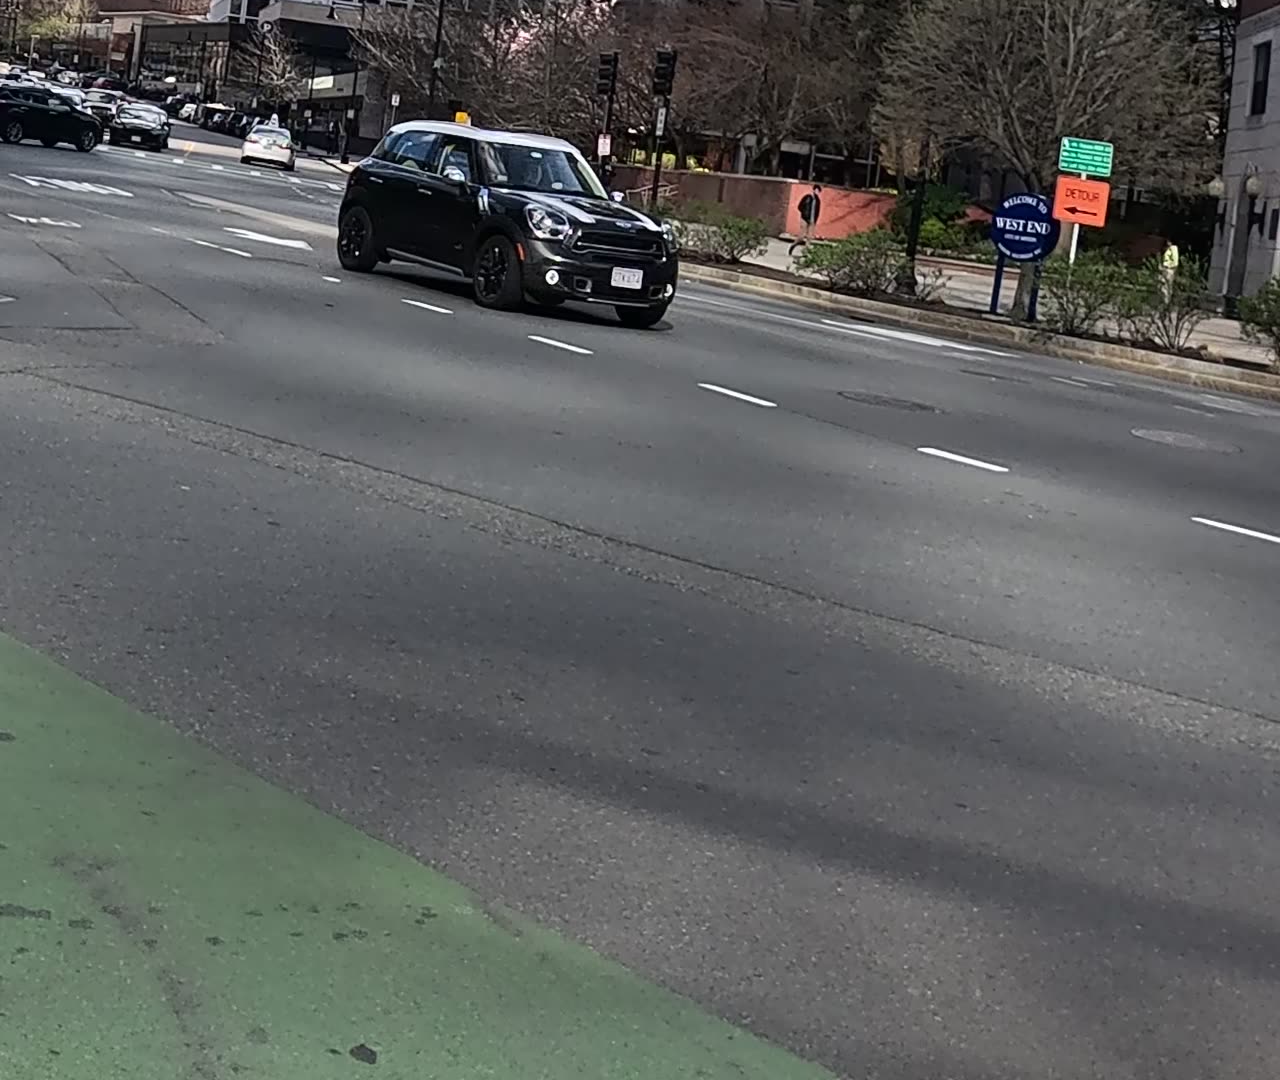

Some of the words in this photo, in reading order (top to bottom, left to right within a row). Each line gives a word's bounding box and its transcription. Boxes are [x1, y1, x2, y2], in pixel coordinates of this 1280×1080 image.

[1003, 195, 1038, 209] WELCOME
[1038, 201, 1048, 214] TO
[1065, 188, 1100, 202] DETOUR
[996, 216, 1026, 232] WEST
[1026, 220, 1051, 235] END
